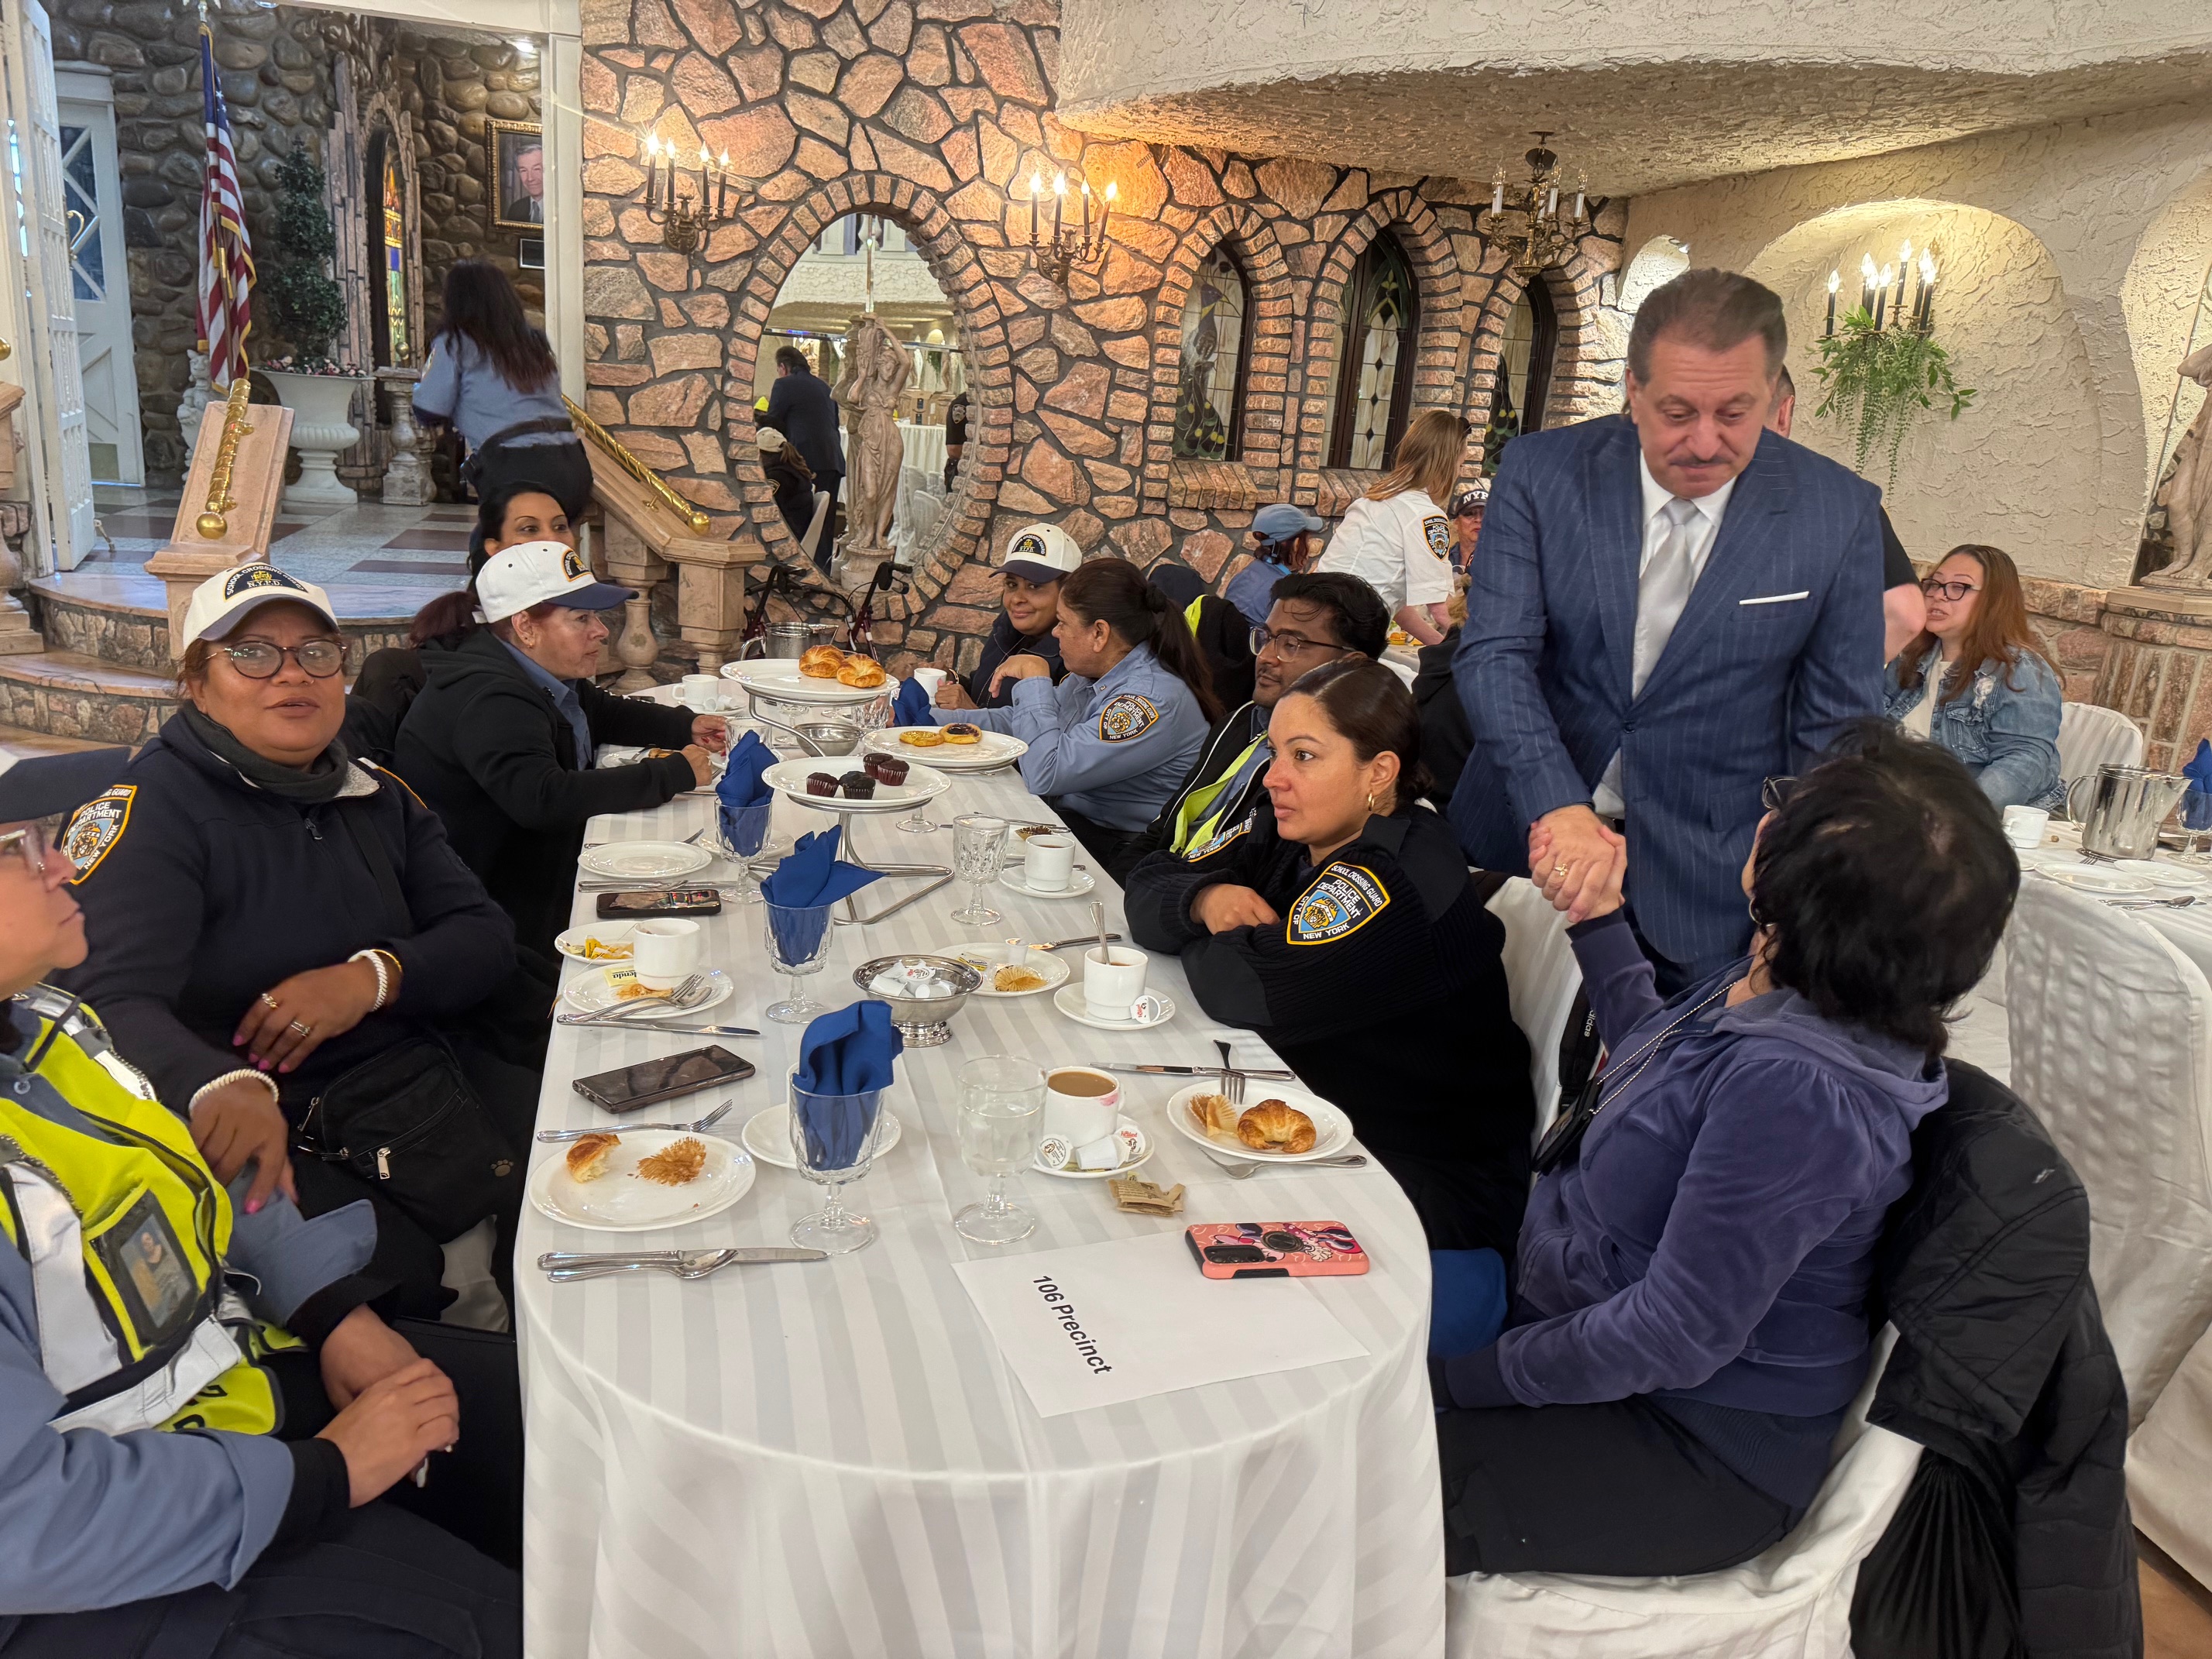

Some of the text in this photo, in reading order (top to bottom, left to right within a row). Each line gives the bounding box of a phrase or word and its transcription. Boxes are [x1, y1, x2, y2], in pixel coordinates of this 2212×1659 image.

[1463, 490, 1489, 504] NYP
[227, 571, 244, 596] SCHOOL
[242, 565, 283, 575] CROSSING
[247, 580, 283, 589] N.Y.P.D.
[1114, 702, 1145, 727] DEPARTMENT
[1125, 700, 1145, 716] POLICE
[1122, 728, 1139, 737] YORK
[79, 802, 112, 819] POLICE
[84, 824, 120, 870] NEW YORK
[1331, 865, 1383, 907] SCHOOL CROSSING GUARD
[1332, 878, 1362, 904] POLICE
[1293, 895, 1310, 926] CITY OF
[1317, 881, 1362, 919] DEPARTMENT
[1325, 922, 1350, 936] YORK
[1584, 1010, 1595, 1037] didas
[1033, 1276, 1112, 1374] 106 Precinct
